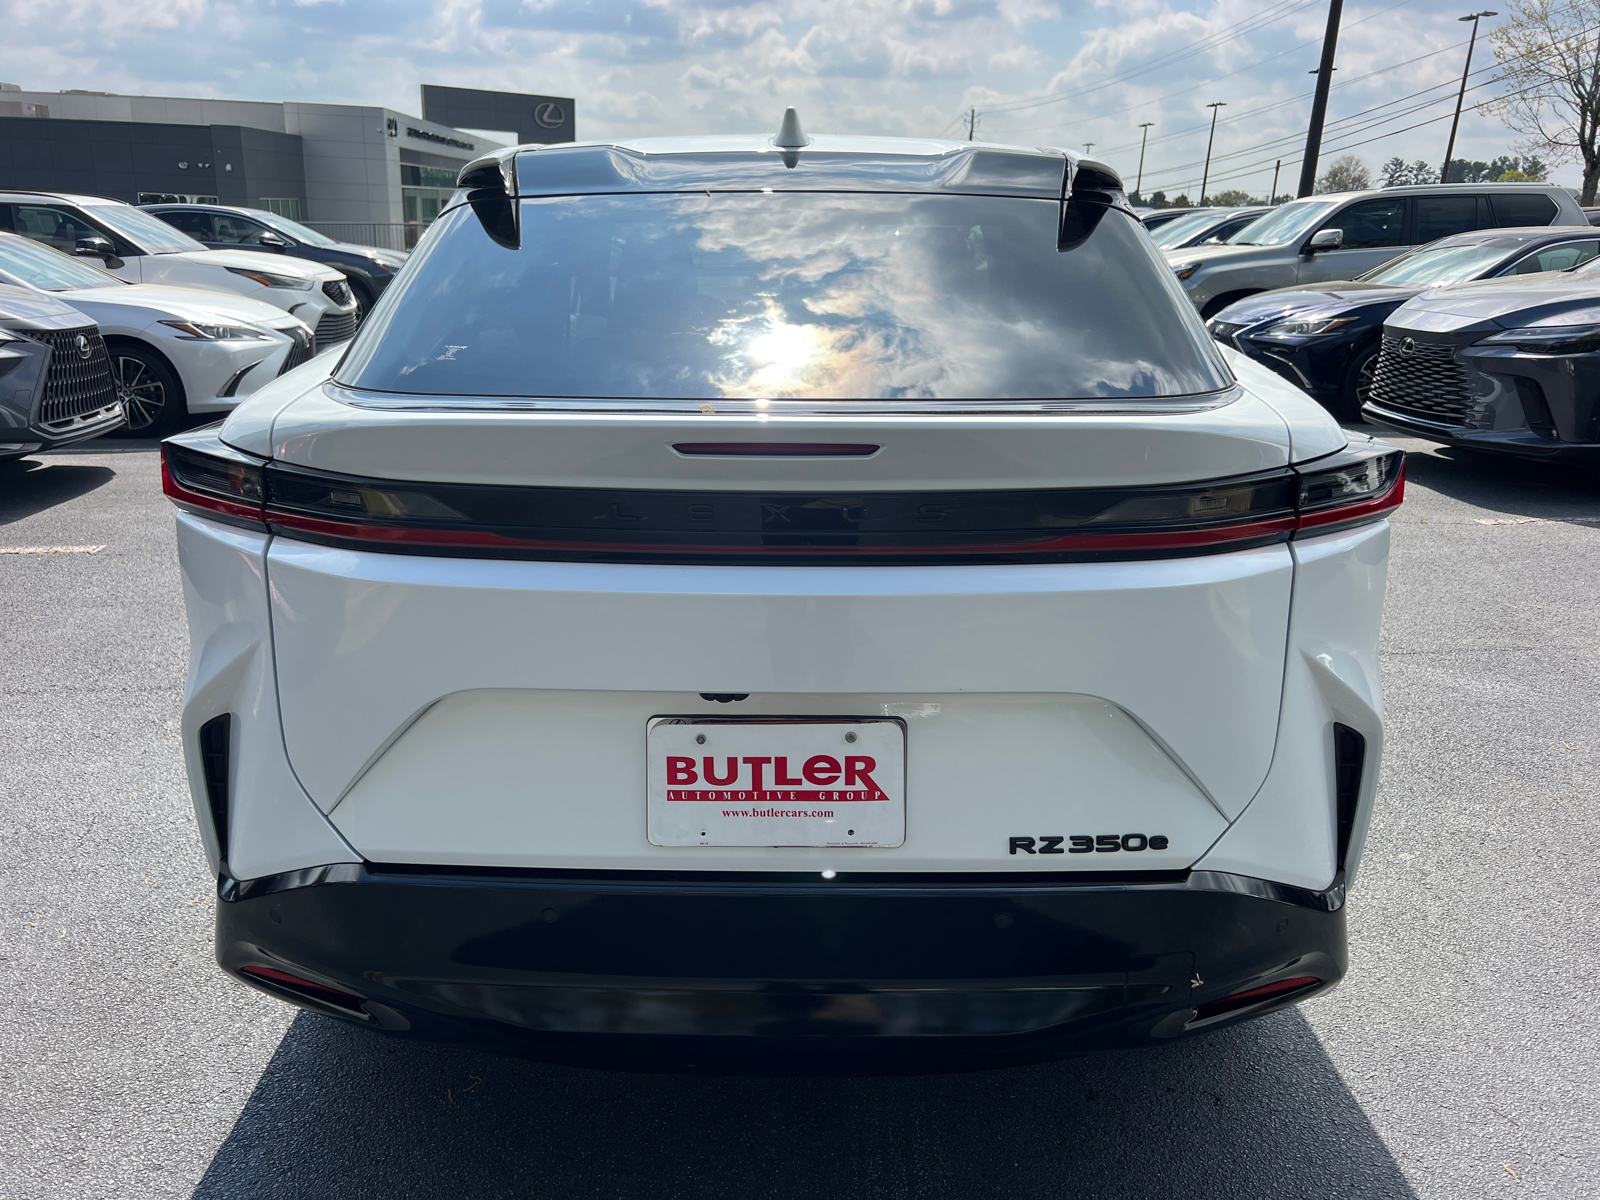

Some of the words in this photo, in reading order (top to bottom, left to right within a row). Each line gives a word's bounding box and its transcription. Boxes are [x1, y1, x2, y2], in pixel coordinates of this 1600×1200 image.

[608, 502, 946, 524] LEXUS
[668, 790, 797, 801] AUTOMOTIVE
[819, 790, 882, 801] GROUP
[722, 808, 834, 819] www.butlercars.com
